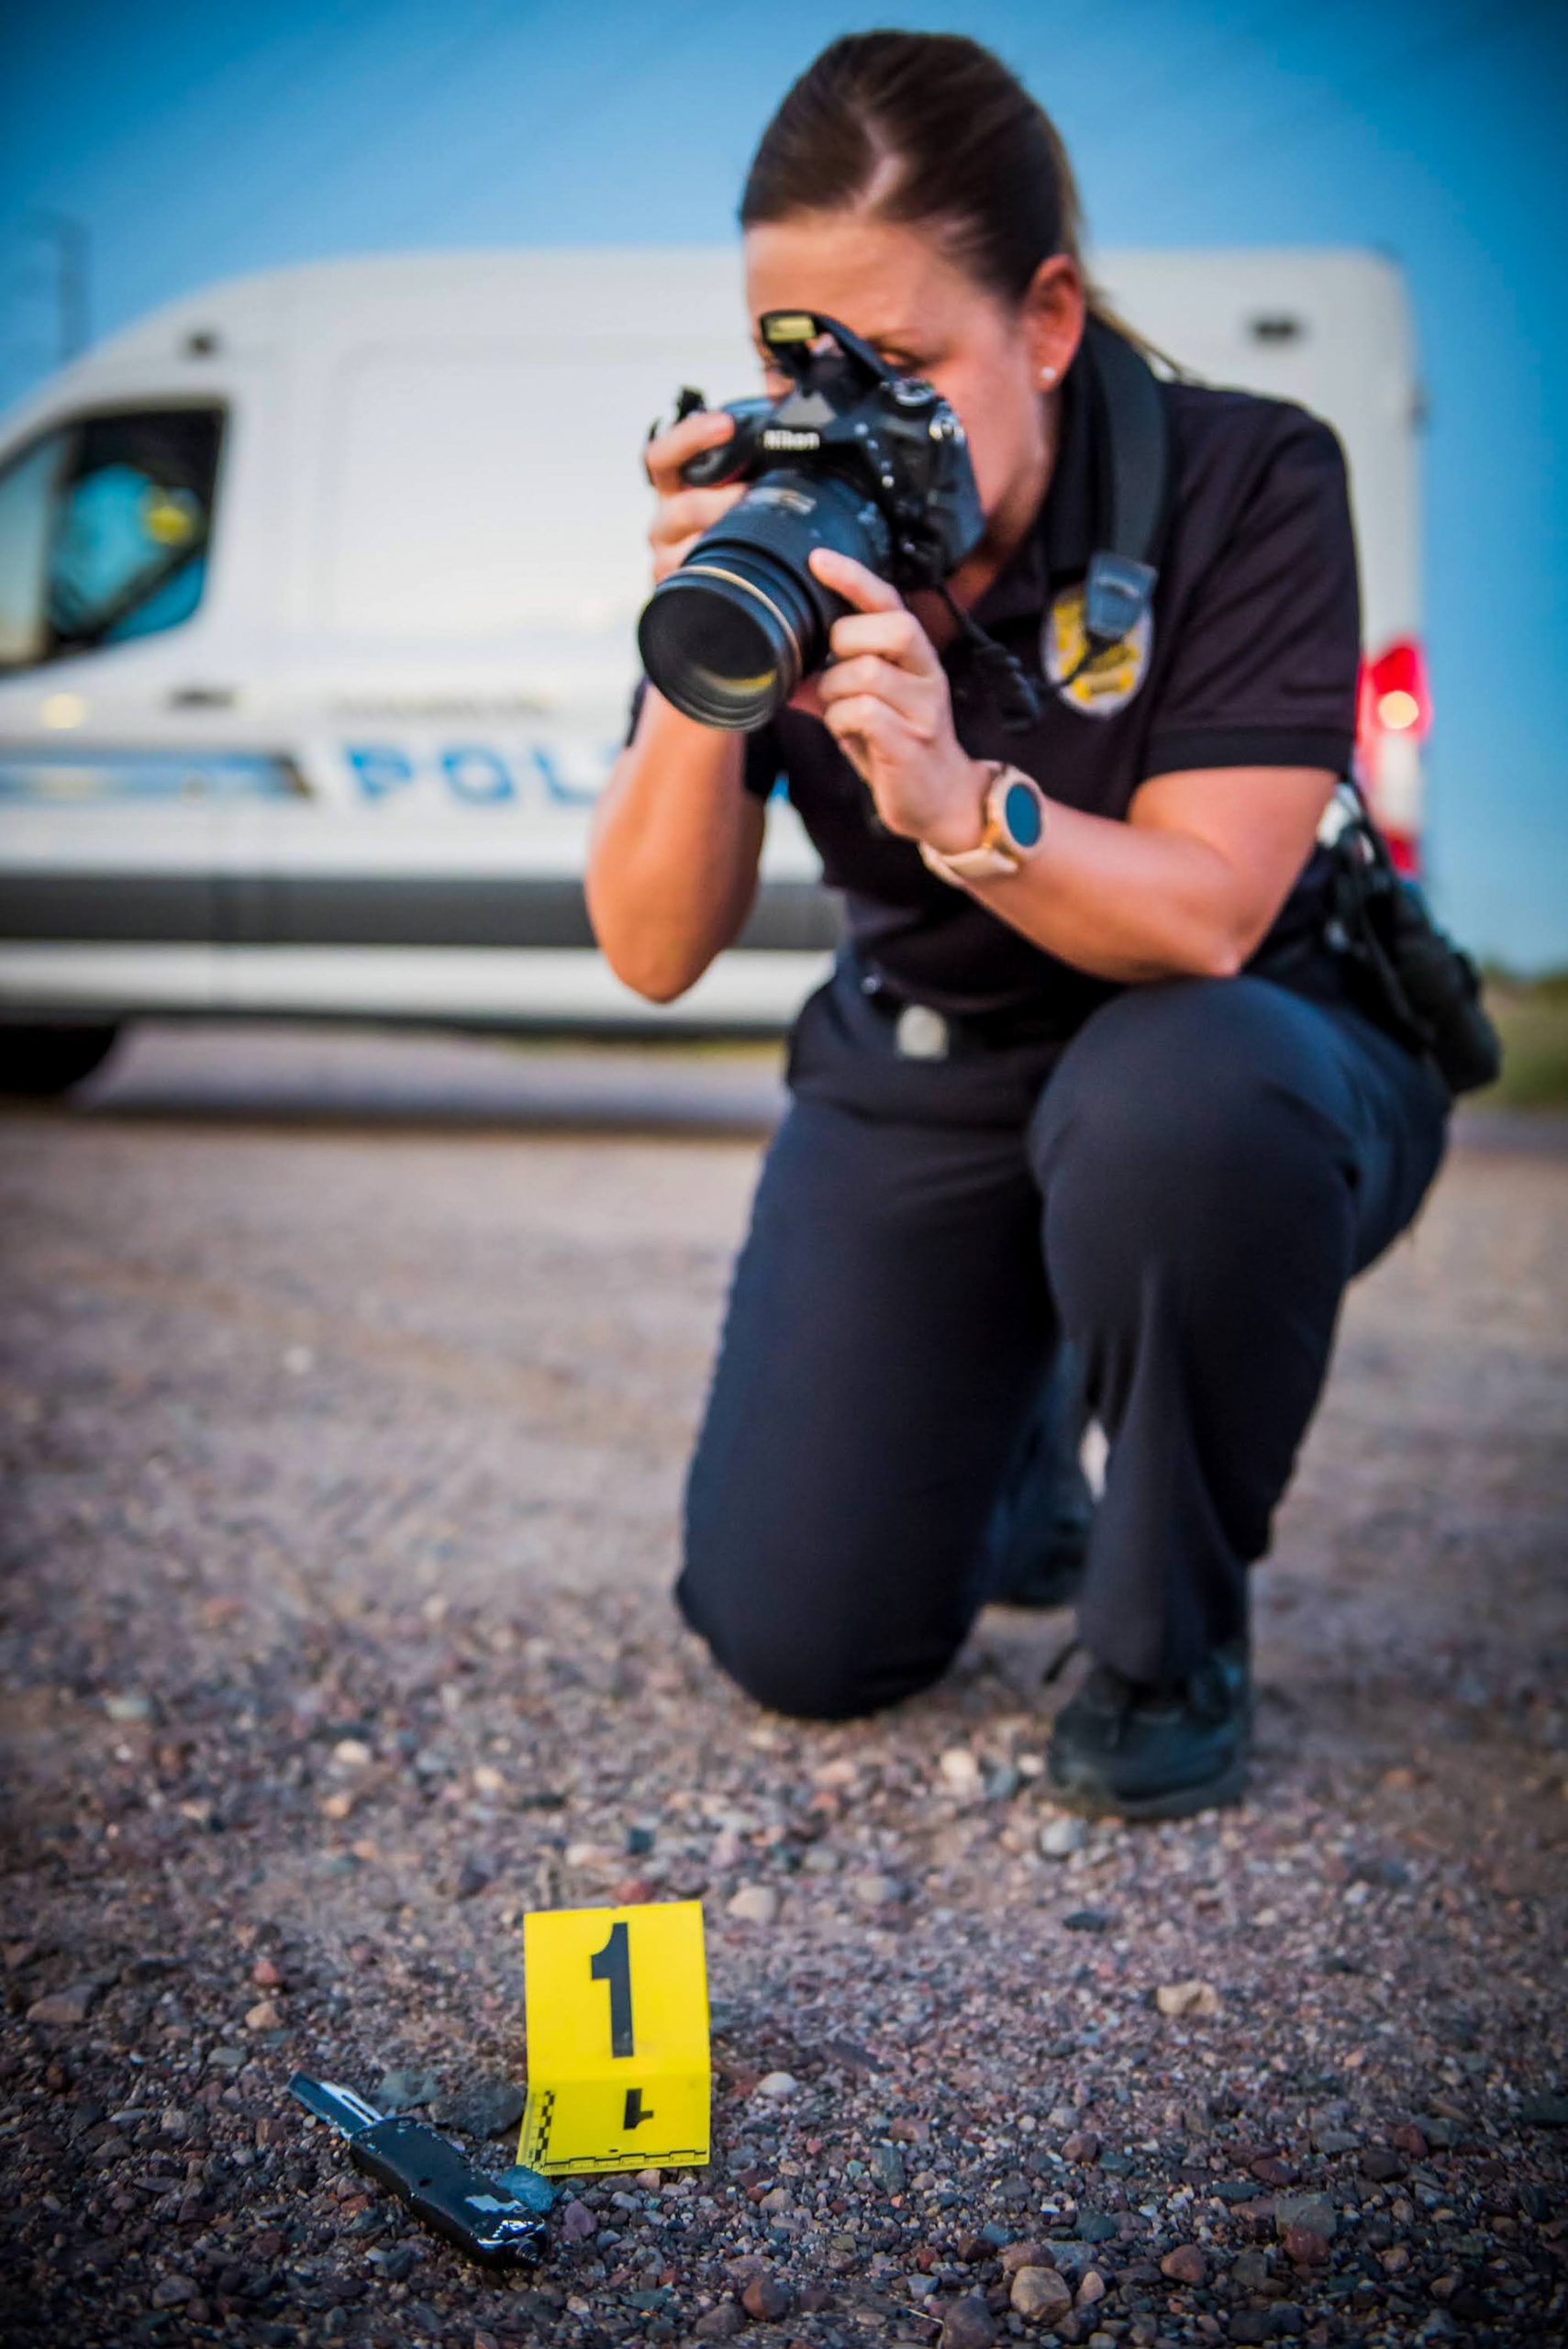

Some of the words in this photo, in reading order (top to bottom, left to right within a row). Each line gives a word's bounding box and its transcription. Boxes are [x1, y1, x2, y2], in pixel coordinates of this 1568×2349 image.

[763, 429, 819, 451] Nikon
[344, 744, 622, 805] POL
[590, 1922, 634, 2058] 1
[623, 2088, 654, 2131] 1
